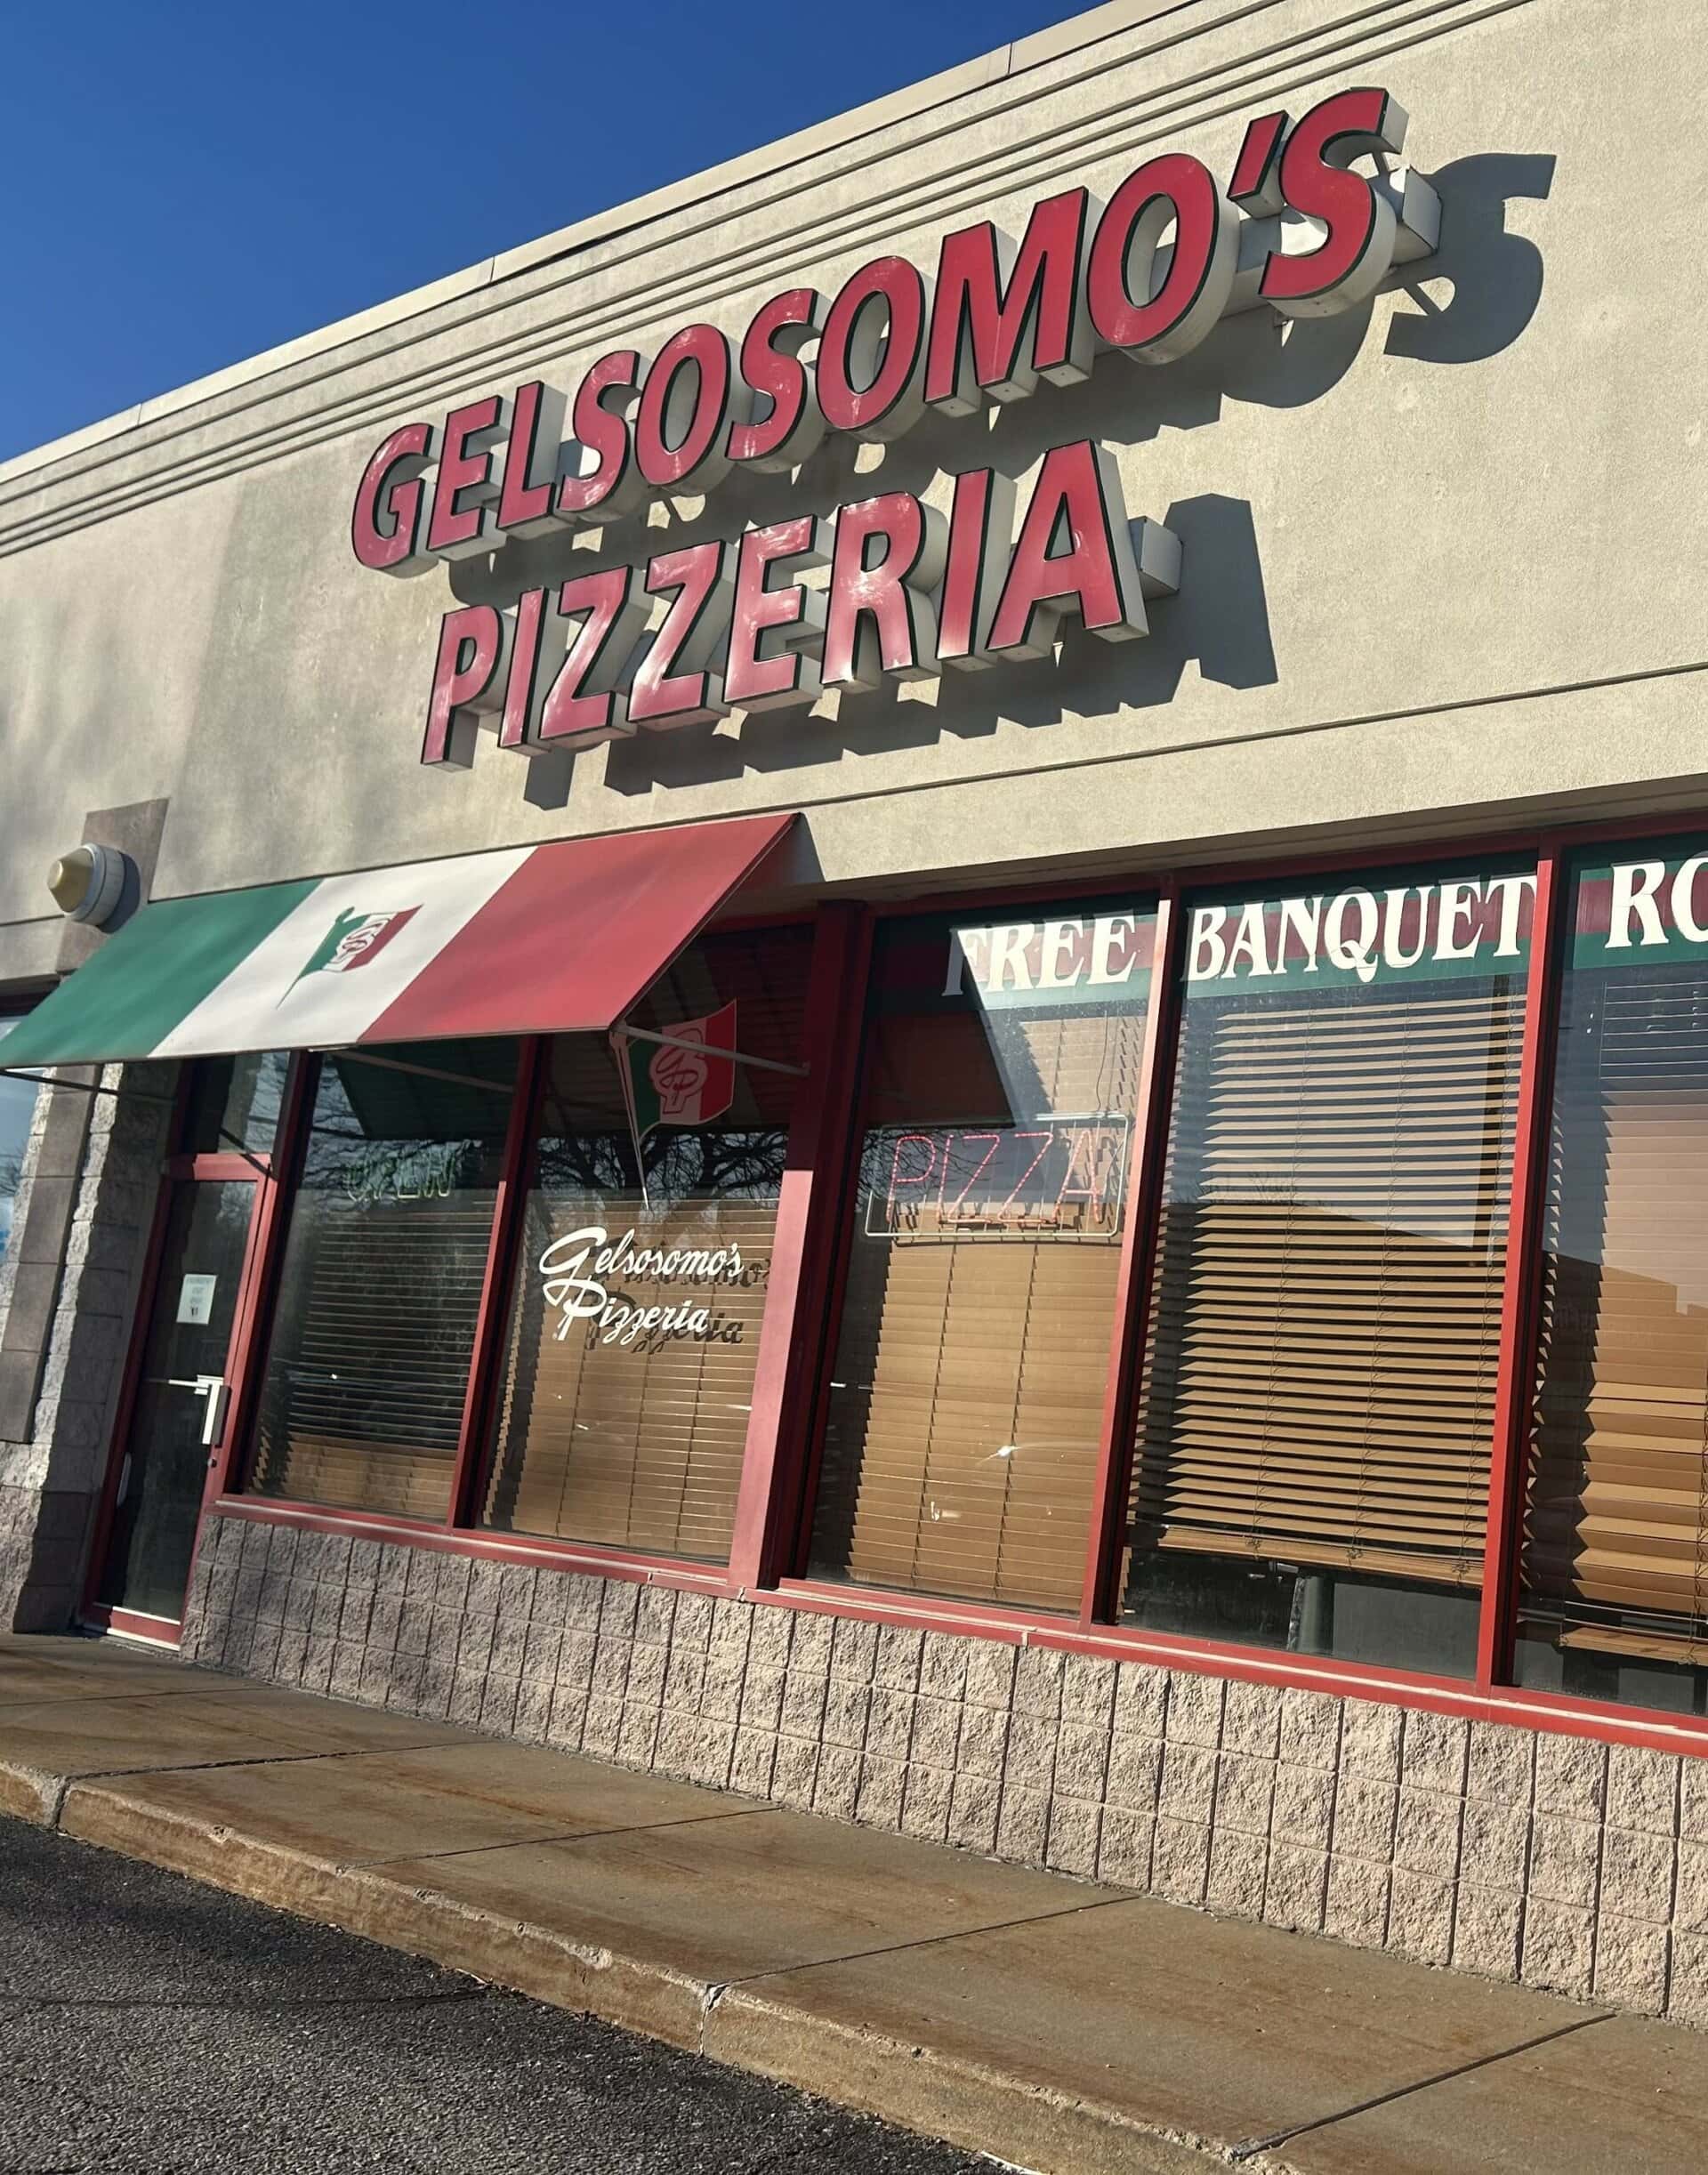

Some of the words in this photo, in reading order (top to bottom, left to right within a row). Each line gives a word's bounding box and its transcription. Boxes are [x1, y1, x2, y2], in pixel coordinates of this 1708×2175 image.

[352, 87, 1395, 571] GELSOSOMO'S
[421, 439, 1134, 767] PIZZERIA
[941, 909, 1138, 997] FREE
[1180, 871, 1537, 983] BANQUET
[886, 1130, 1104, 1224] PIZZA
[539, 1226, 745, 1282] Gelsosomo's
[543, 1277, 711, 1345] Pizzeria
